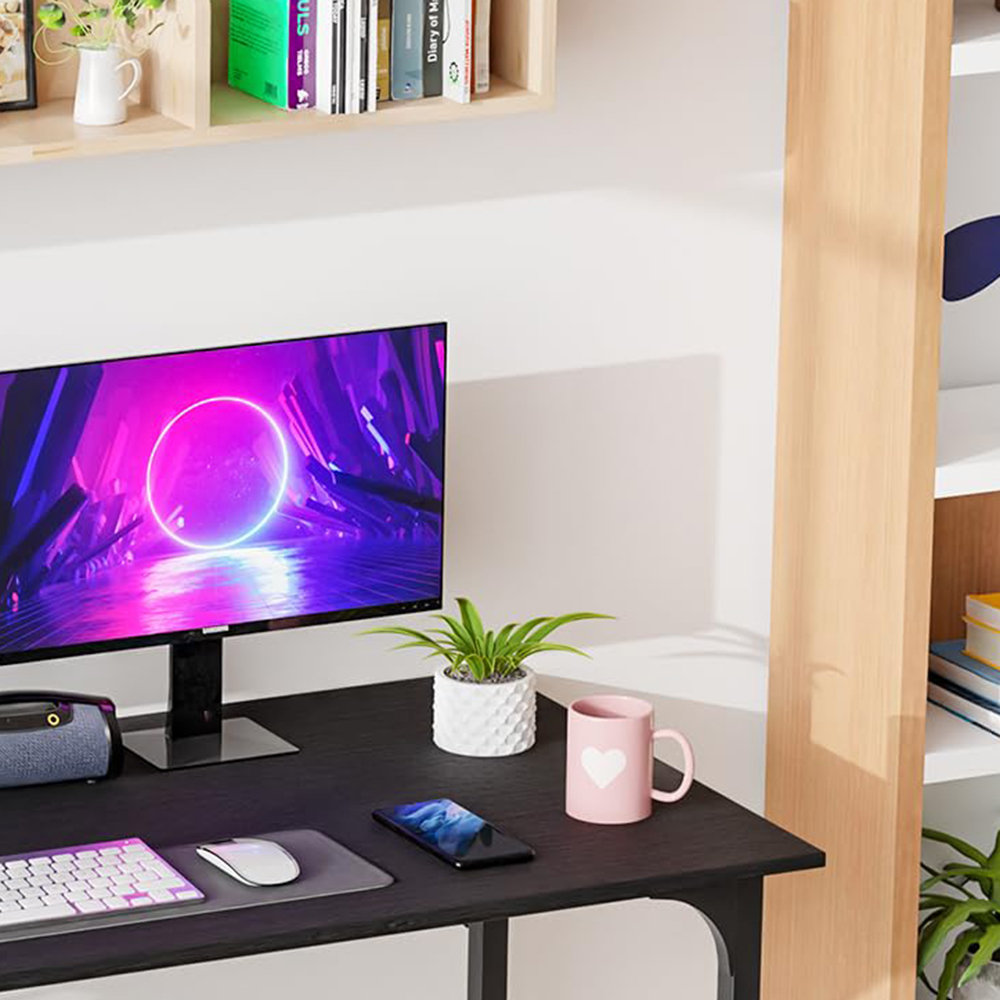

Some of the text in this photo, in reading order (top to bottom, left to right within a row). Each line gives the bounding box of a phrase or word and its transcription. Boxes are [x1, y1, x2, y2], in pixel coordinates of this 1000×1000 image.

[296, 0, 310, 36] ULS
[428, 14, 439, 28] of
[426, 29, 440, 63] Diary
